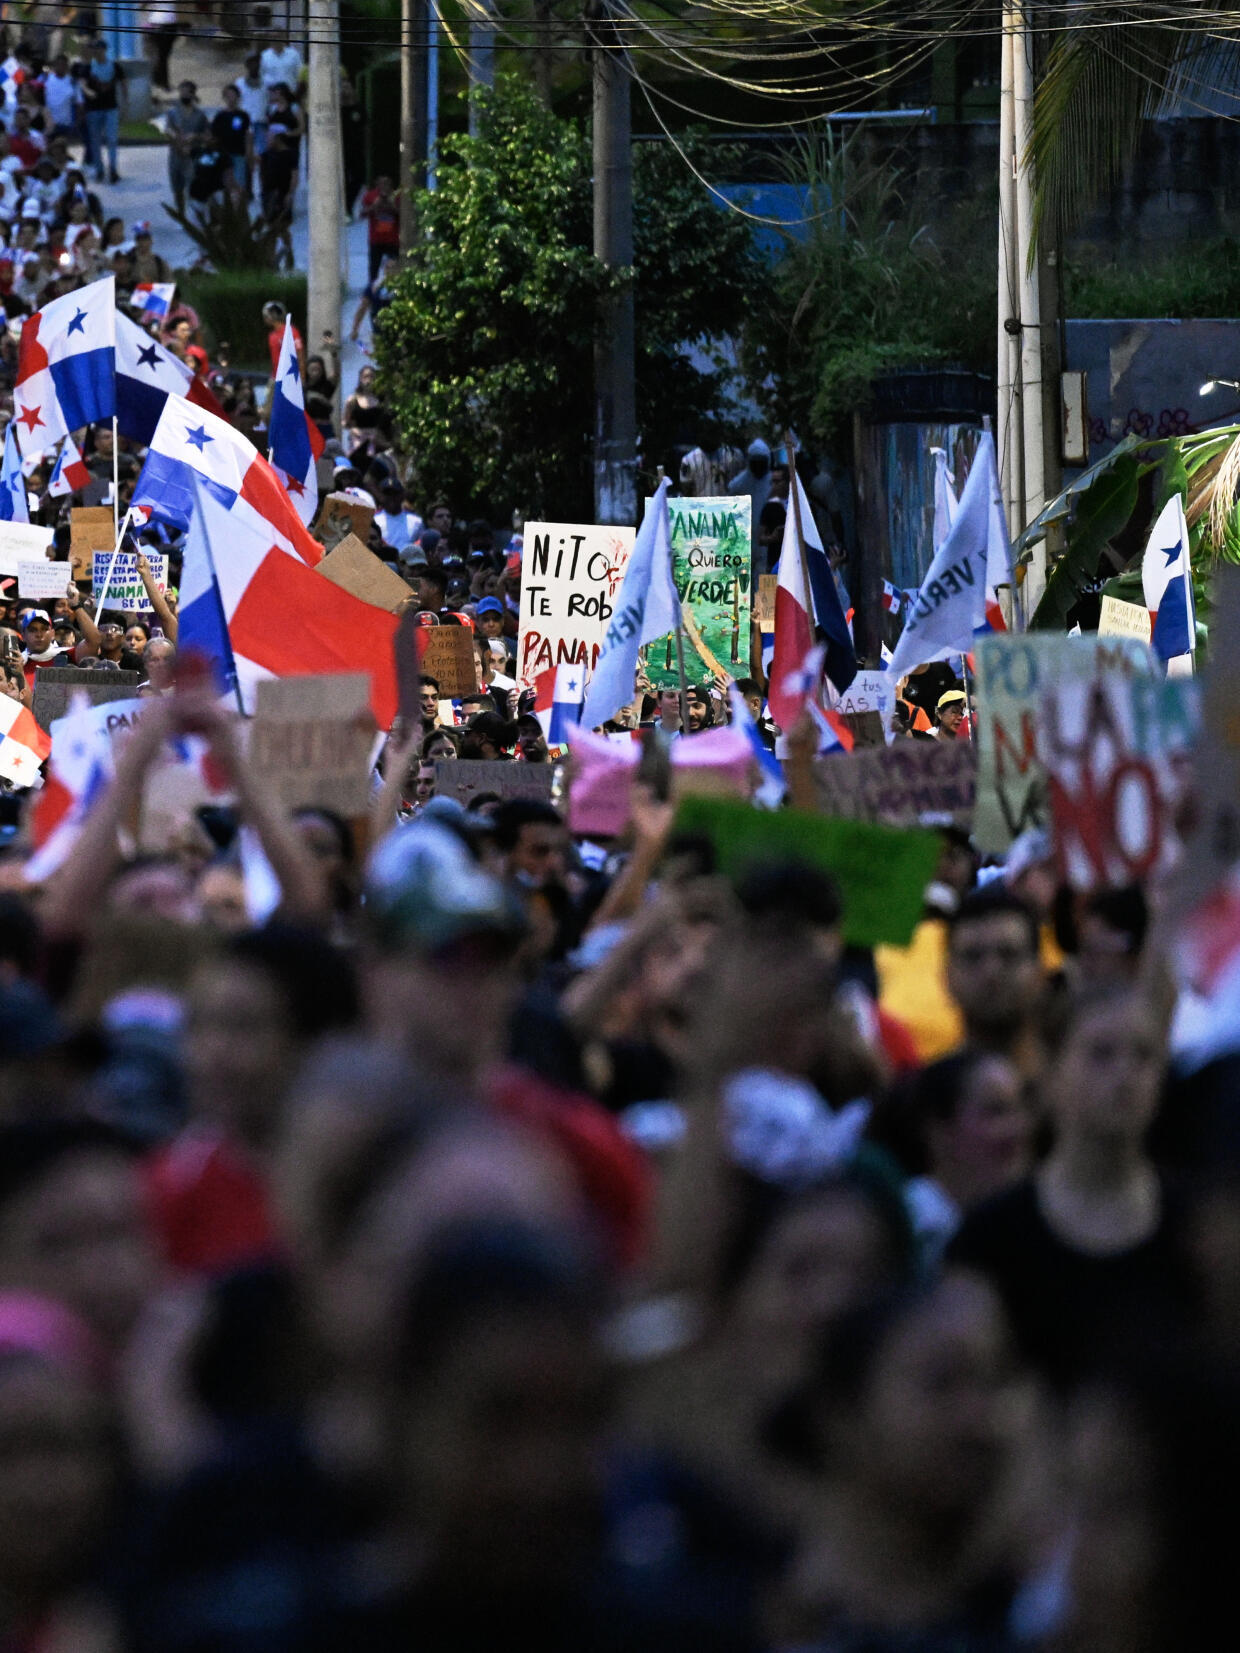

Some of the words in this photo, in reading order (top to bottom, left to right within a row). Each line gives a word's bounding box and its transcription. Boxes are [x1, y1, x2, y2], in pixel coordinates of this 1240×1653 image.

[95, 554, 129, 565] RESETA
[94, 566, 126, 575] RESETA
[95, 585, 144, 599] PNAMA
